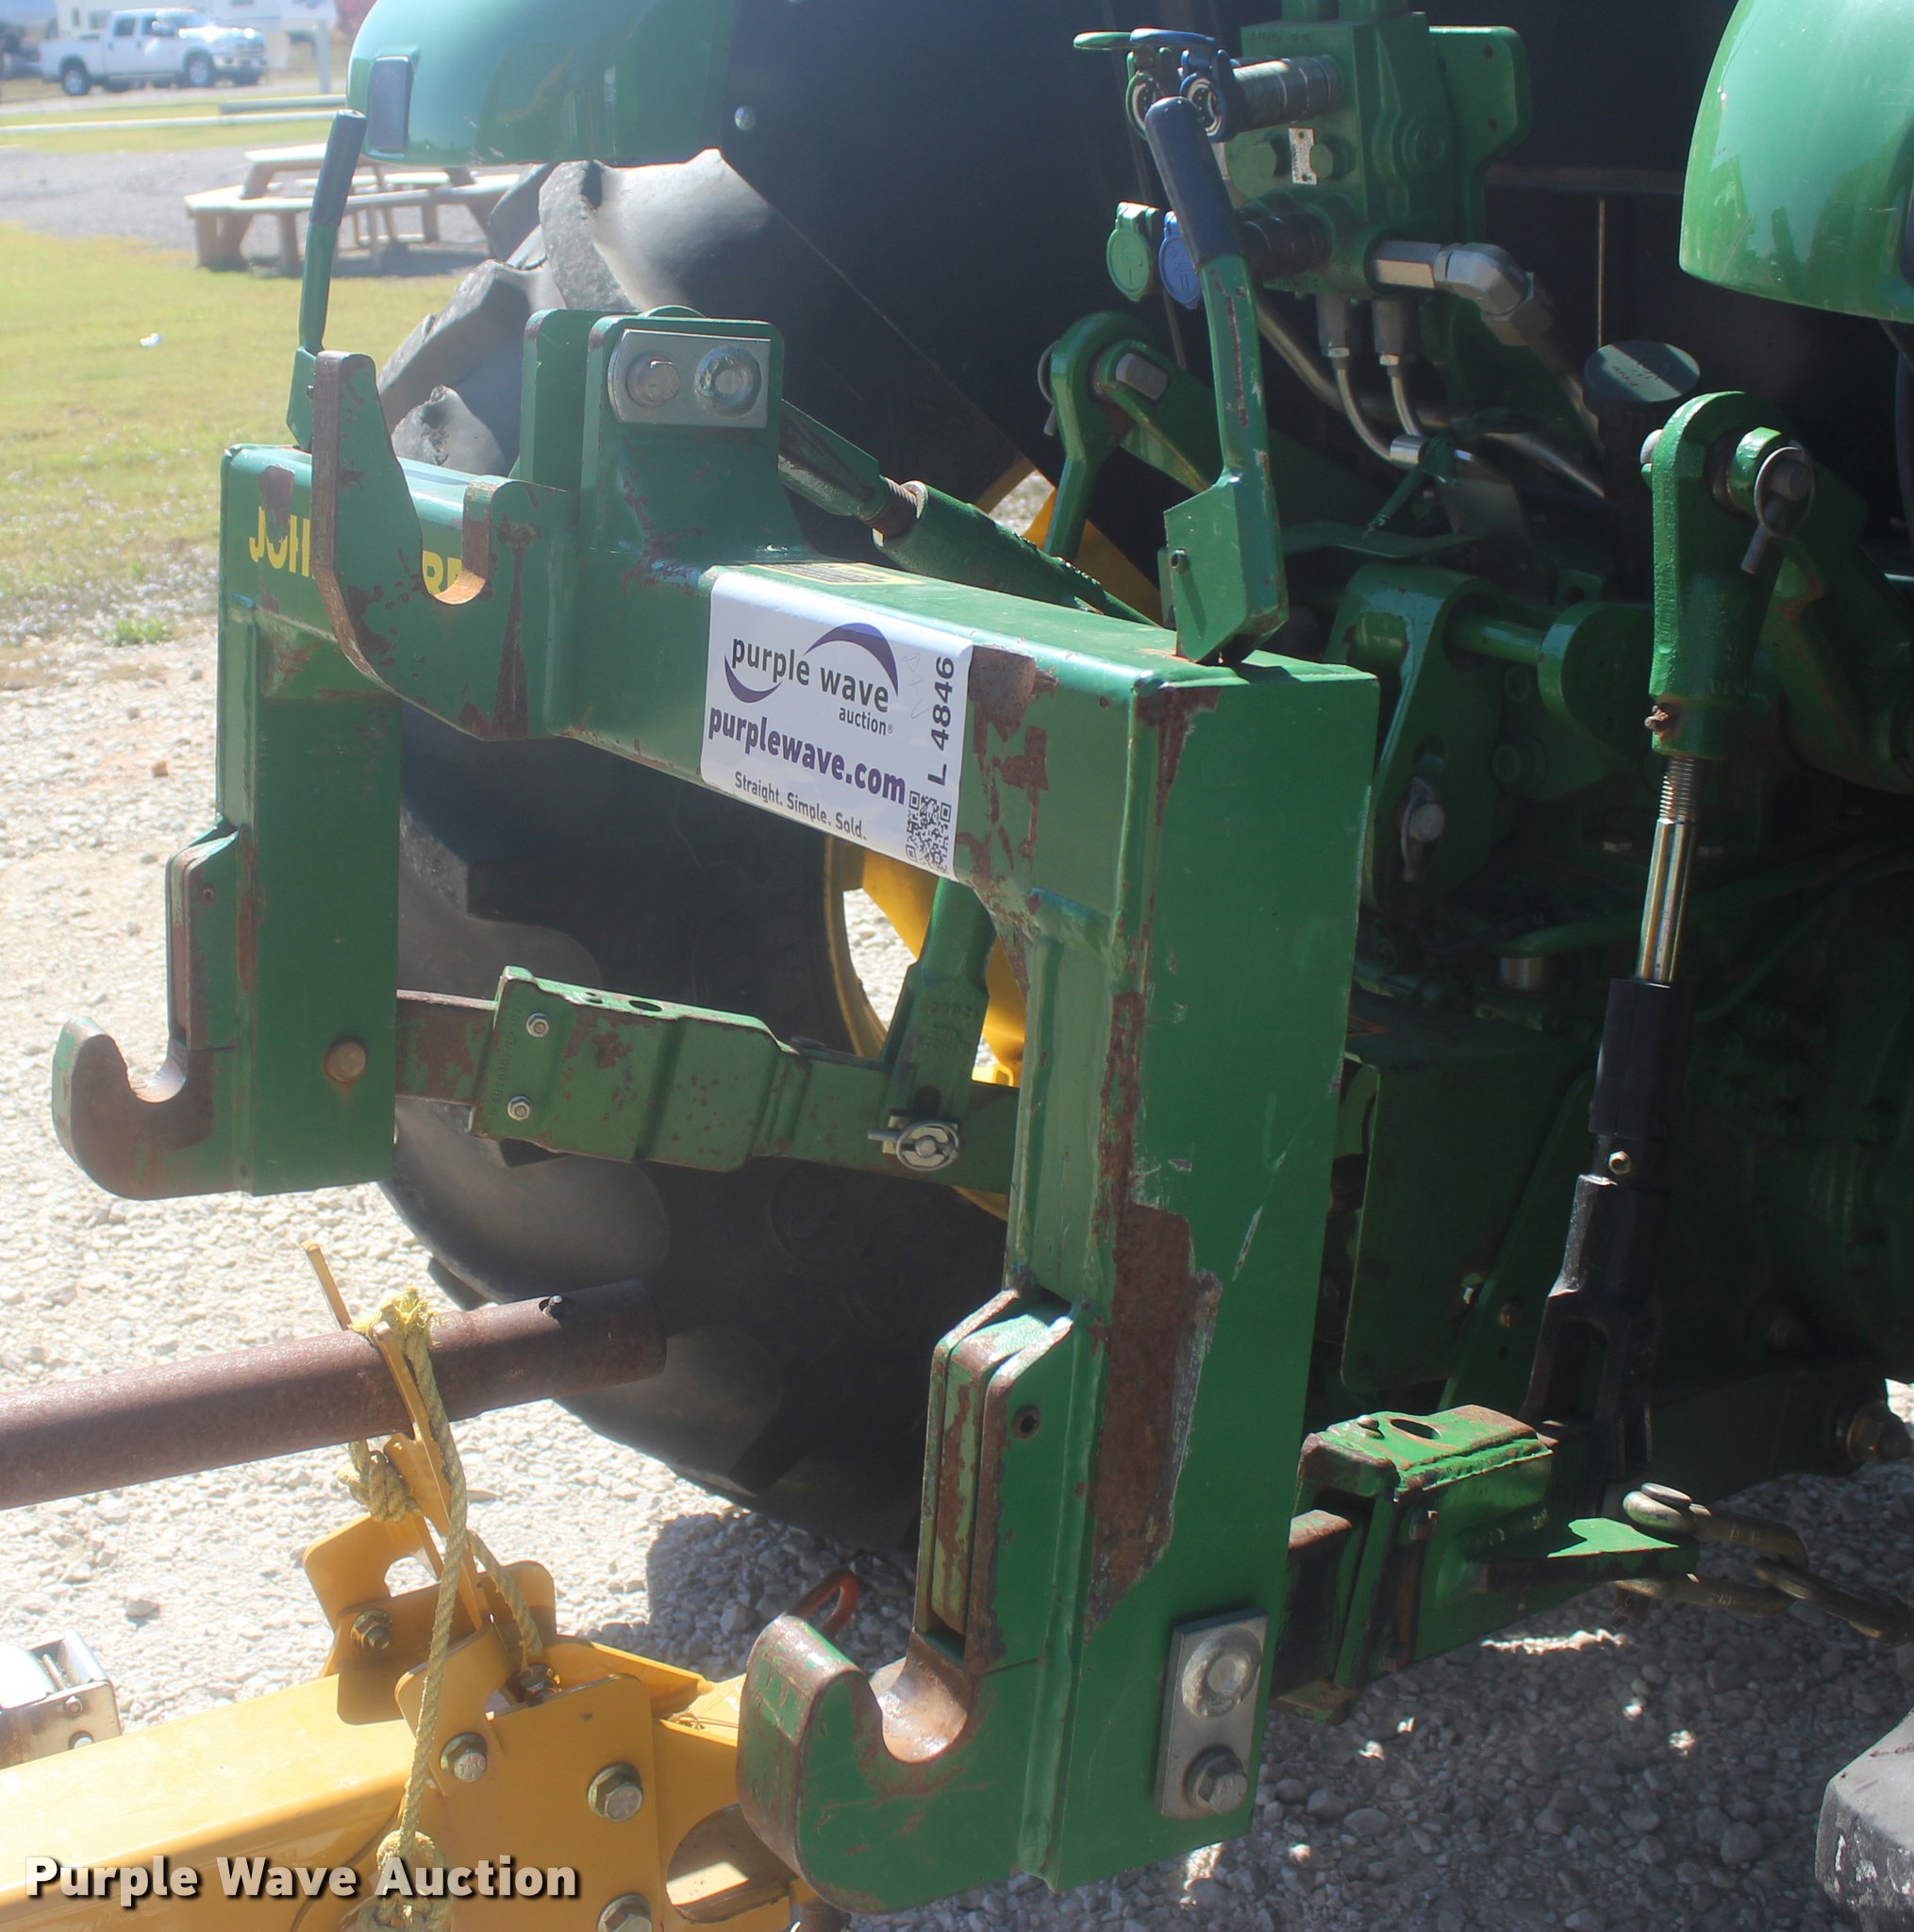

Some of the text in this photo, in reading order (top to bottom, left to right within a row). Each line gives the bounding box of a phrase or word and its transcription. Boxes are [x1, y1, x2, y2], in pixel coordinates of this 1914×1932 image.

[731, 638, 810, 687] purple
[821, 667, 890, 712] wave
[707, 707, 906, 805] purplewave.com
[927, 657, 955, 786] L 4846
[734, 771, 868, 841] Straight. Simple. Sold.
